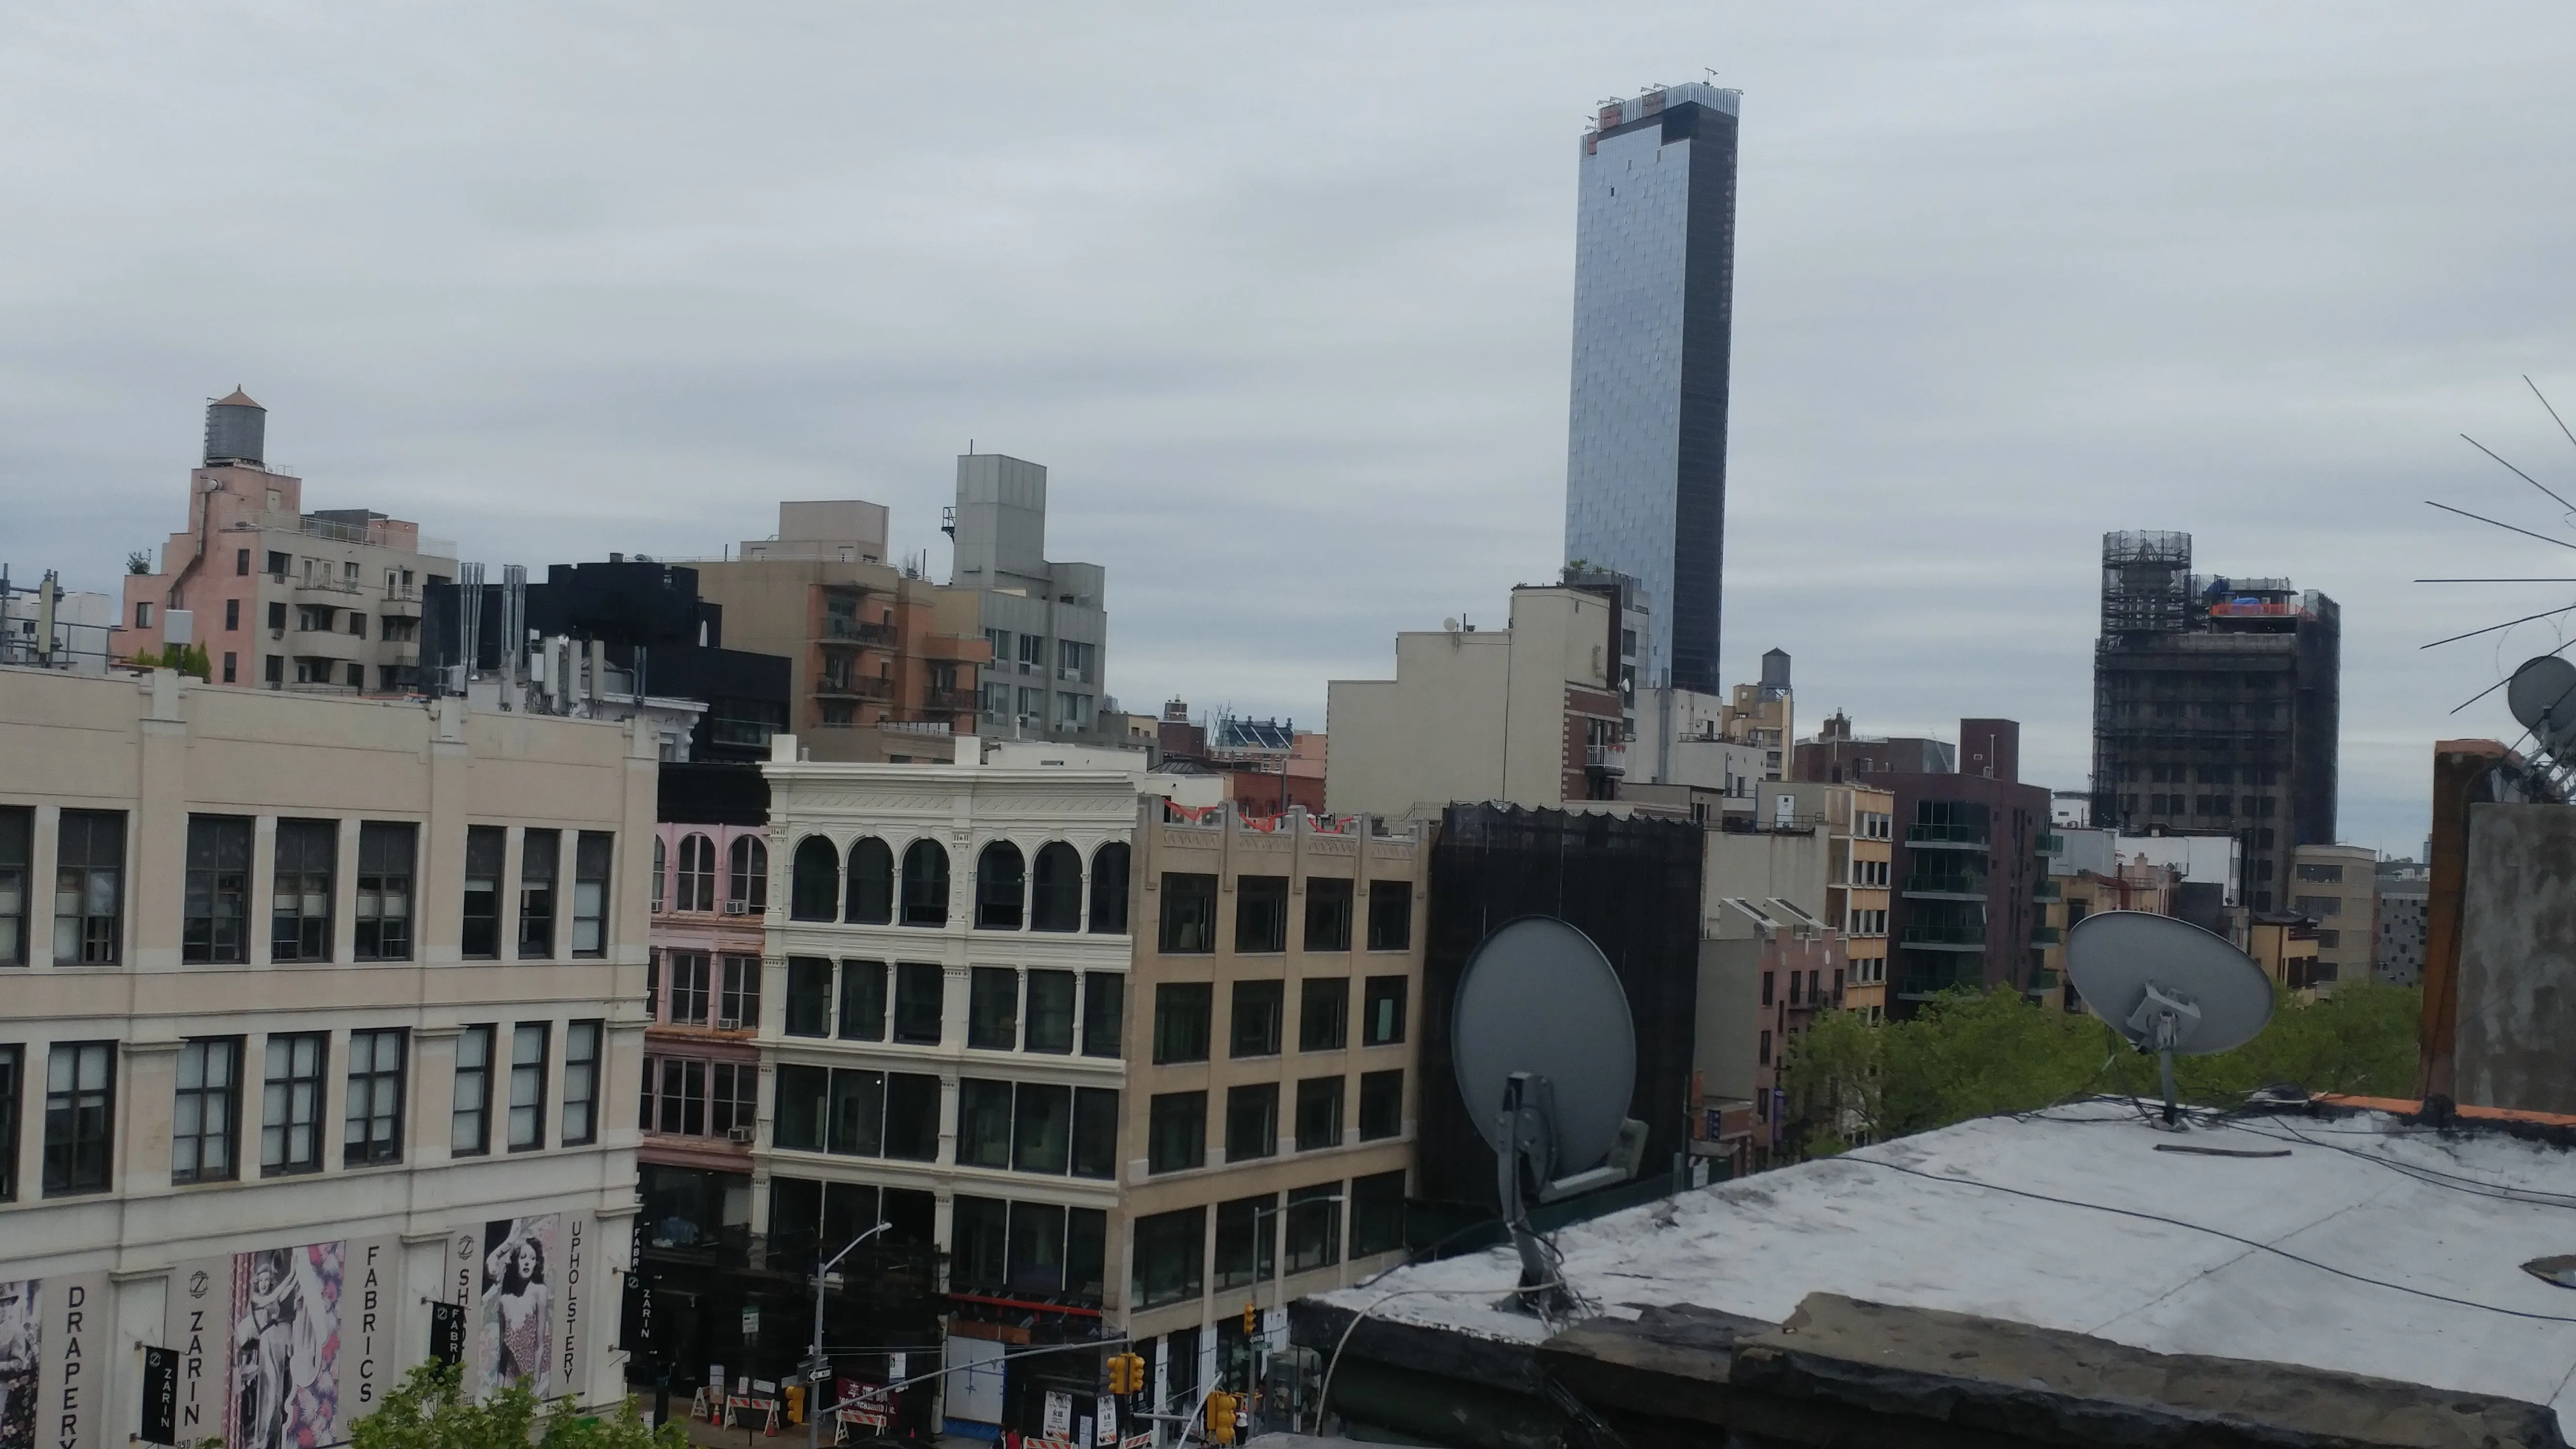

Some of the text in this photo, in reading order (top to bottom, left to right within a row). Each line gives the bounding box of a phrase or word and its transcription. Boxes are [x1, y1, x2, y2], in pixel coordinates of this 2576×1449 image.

[632, 1228, 641, 1273] FABRI
[360, 1245, 379, 1402] FABRICS
[564, 1221, 582, 1384] UPHOLSTERY
[641, 1288, 651, 1338] ZARIN
[450, 1309, 460, 1364] FABRI
[161, 1368, 173, 1428] ZARIN
[184, 1311, 204, 1426] ZARIN
